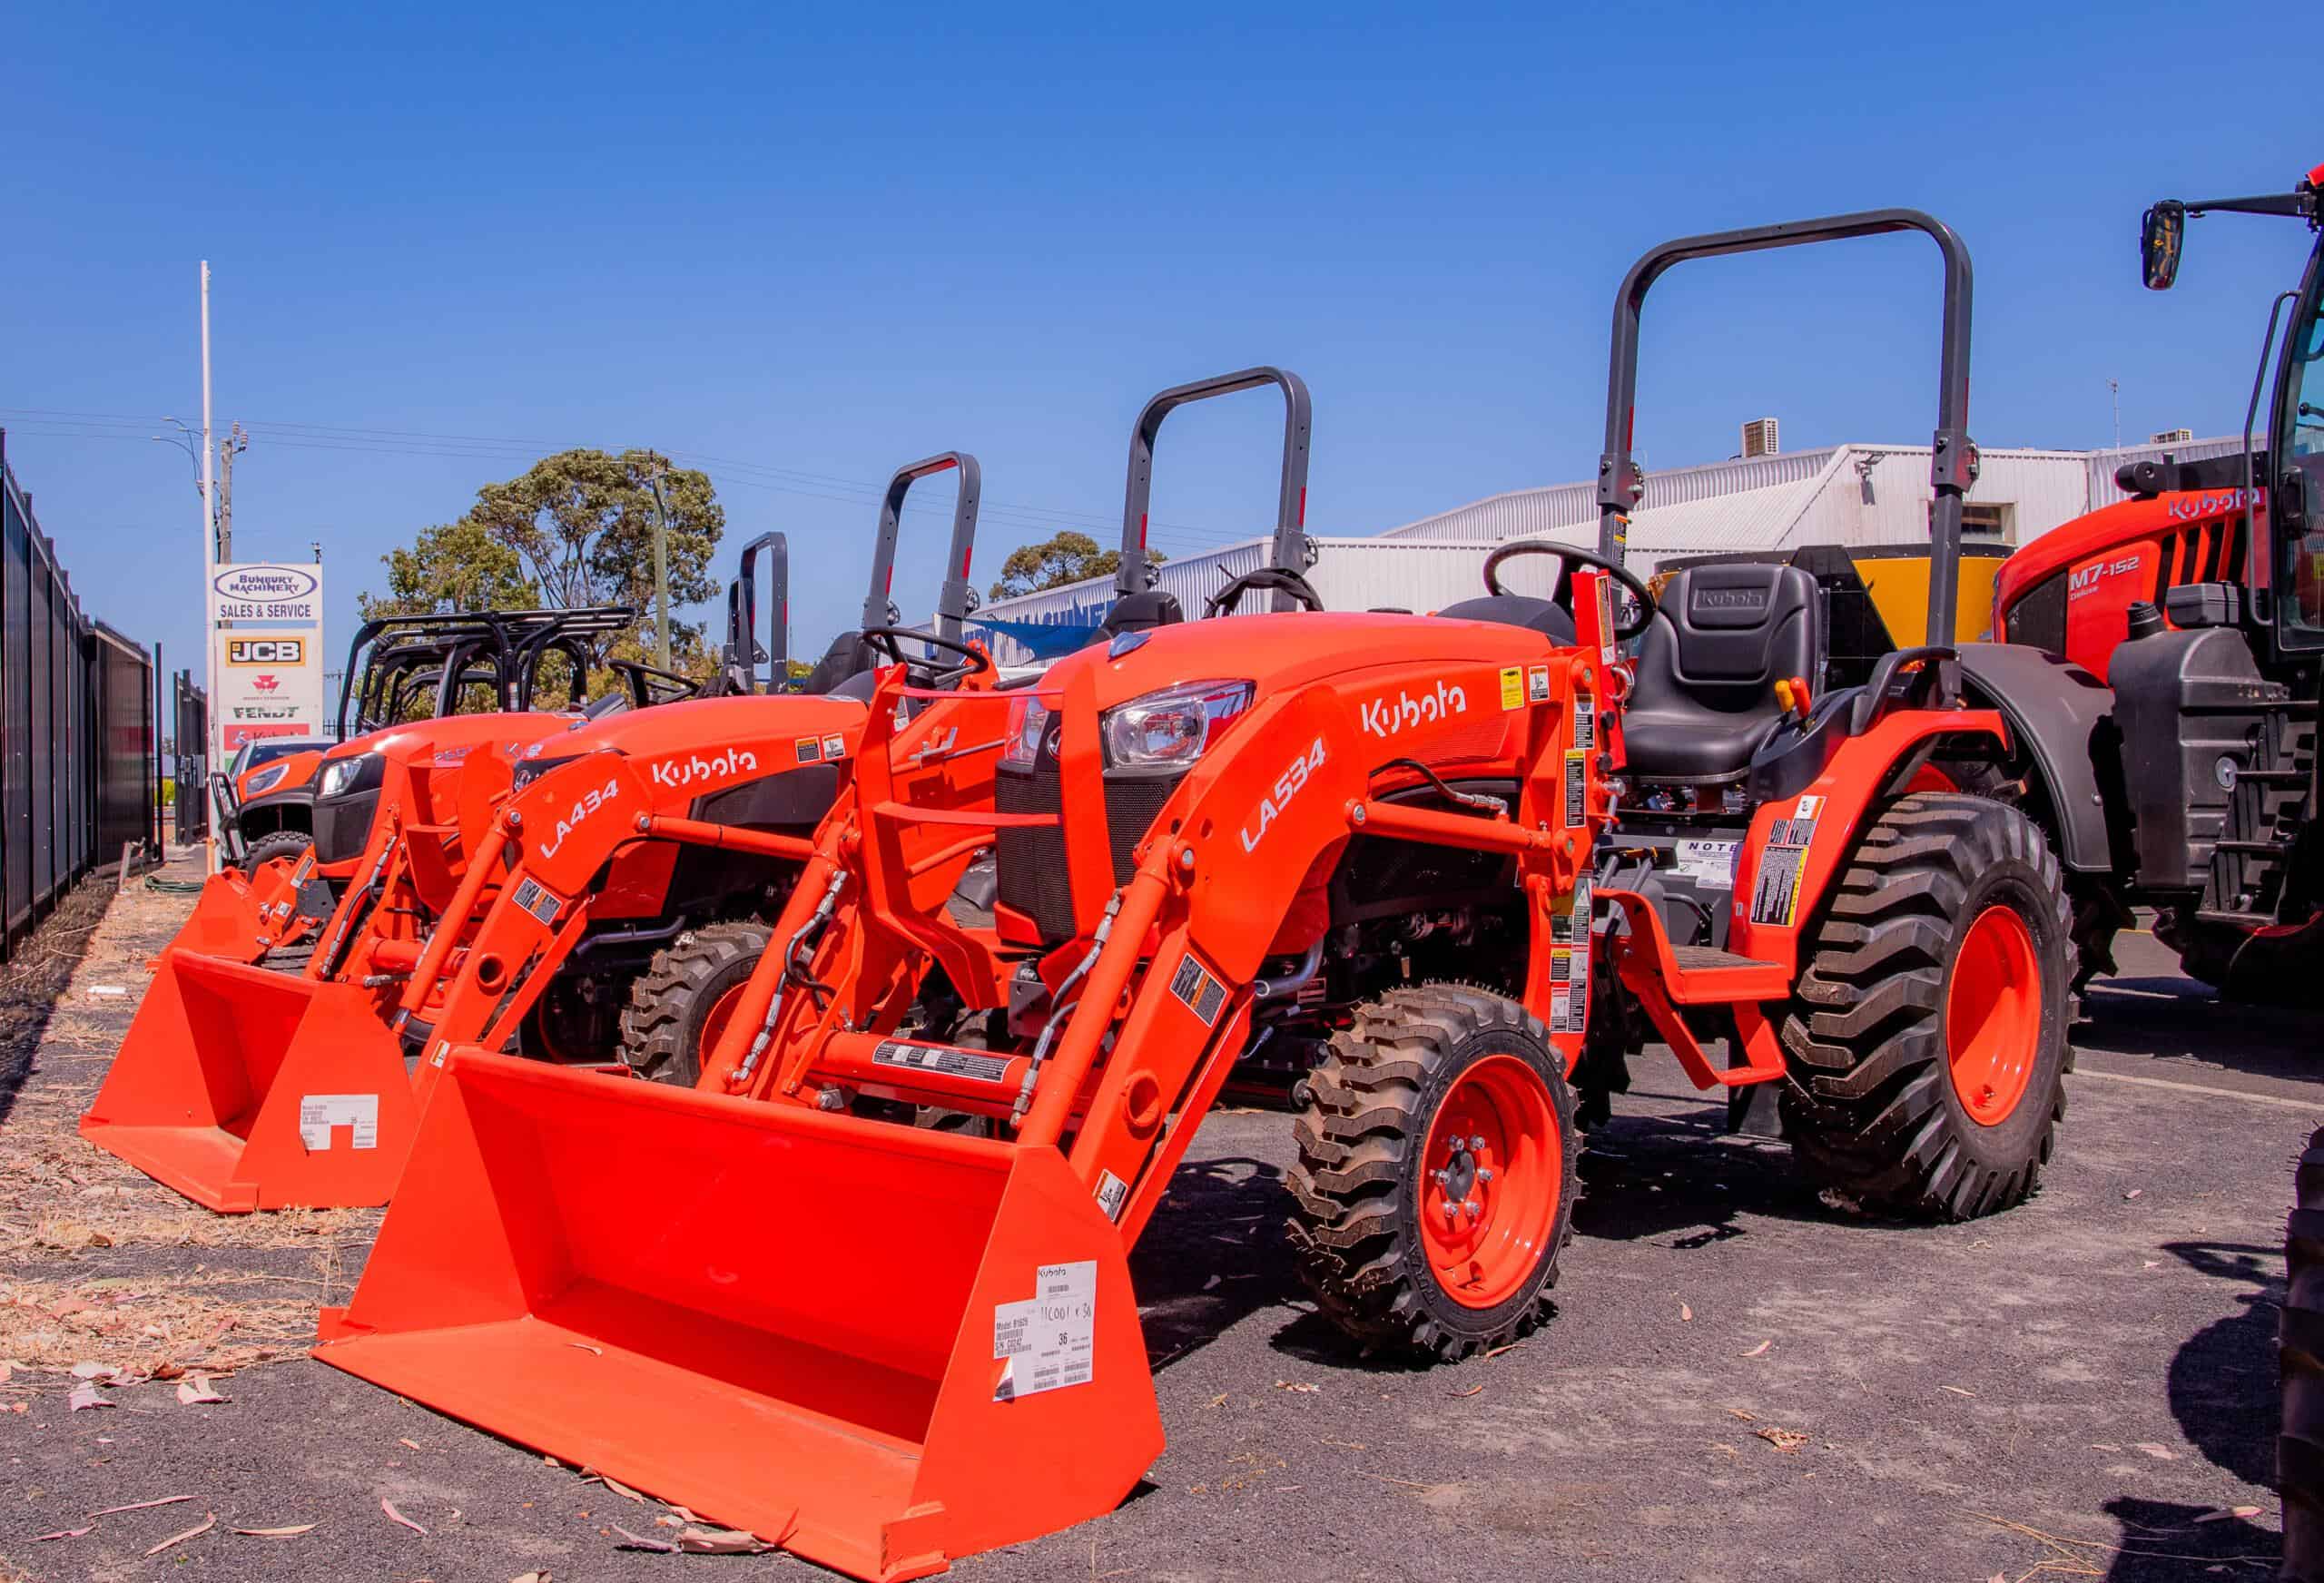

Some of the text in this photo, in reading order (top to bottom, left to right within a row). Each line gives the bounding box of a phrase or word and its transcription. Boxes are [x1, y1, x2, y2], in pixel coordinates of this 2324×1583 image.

[2069, 556, 2141, 591] M7-152
[230, 583, 300, 595] MACHINERY
[221, 604, 311, 618] SALES & SERVICE
[231, 642, 300, 662] JCB
[233, 707, 300, 719] FENDT
[1361, 680, 1467, 738] Kubota
[651, 747, 758, 788] Kubota
[1240, 736, 1326, 853] LA534
[540, 779, 619, 859] LA434
[1038, 1266, 1067, 1278] Kubota
